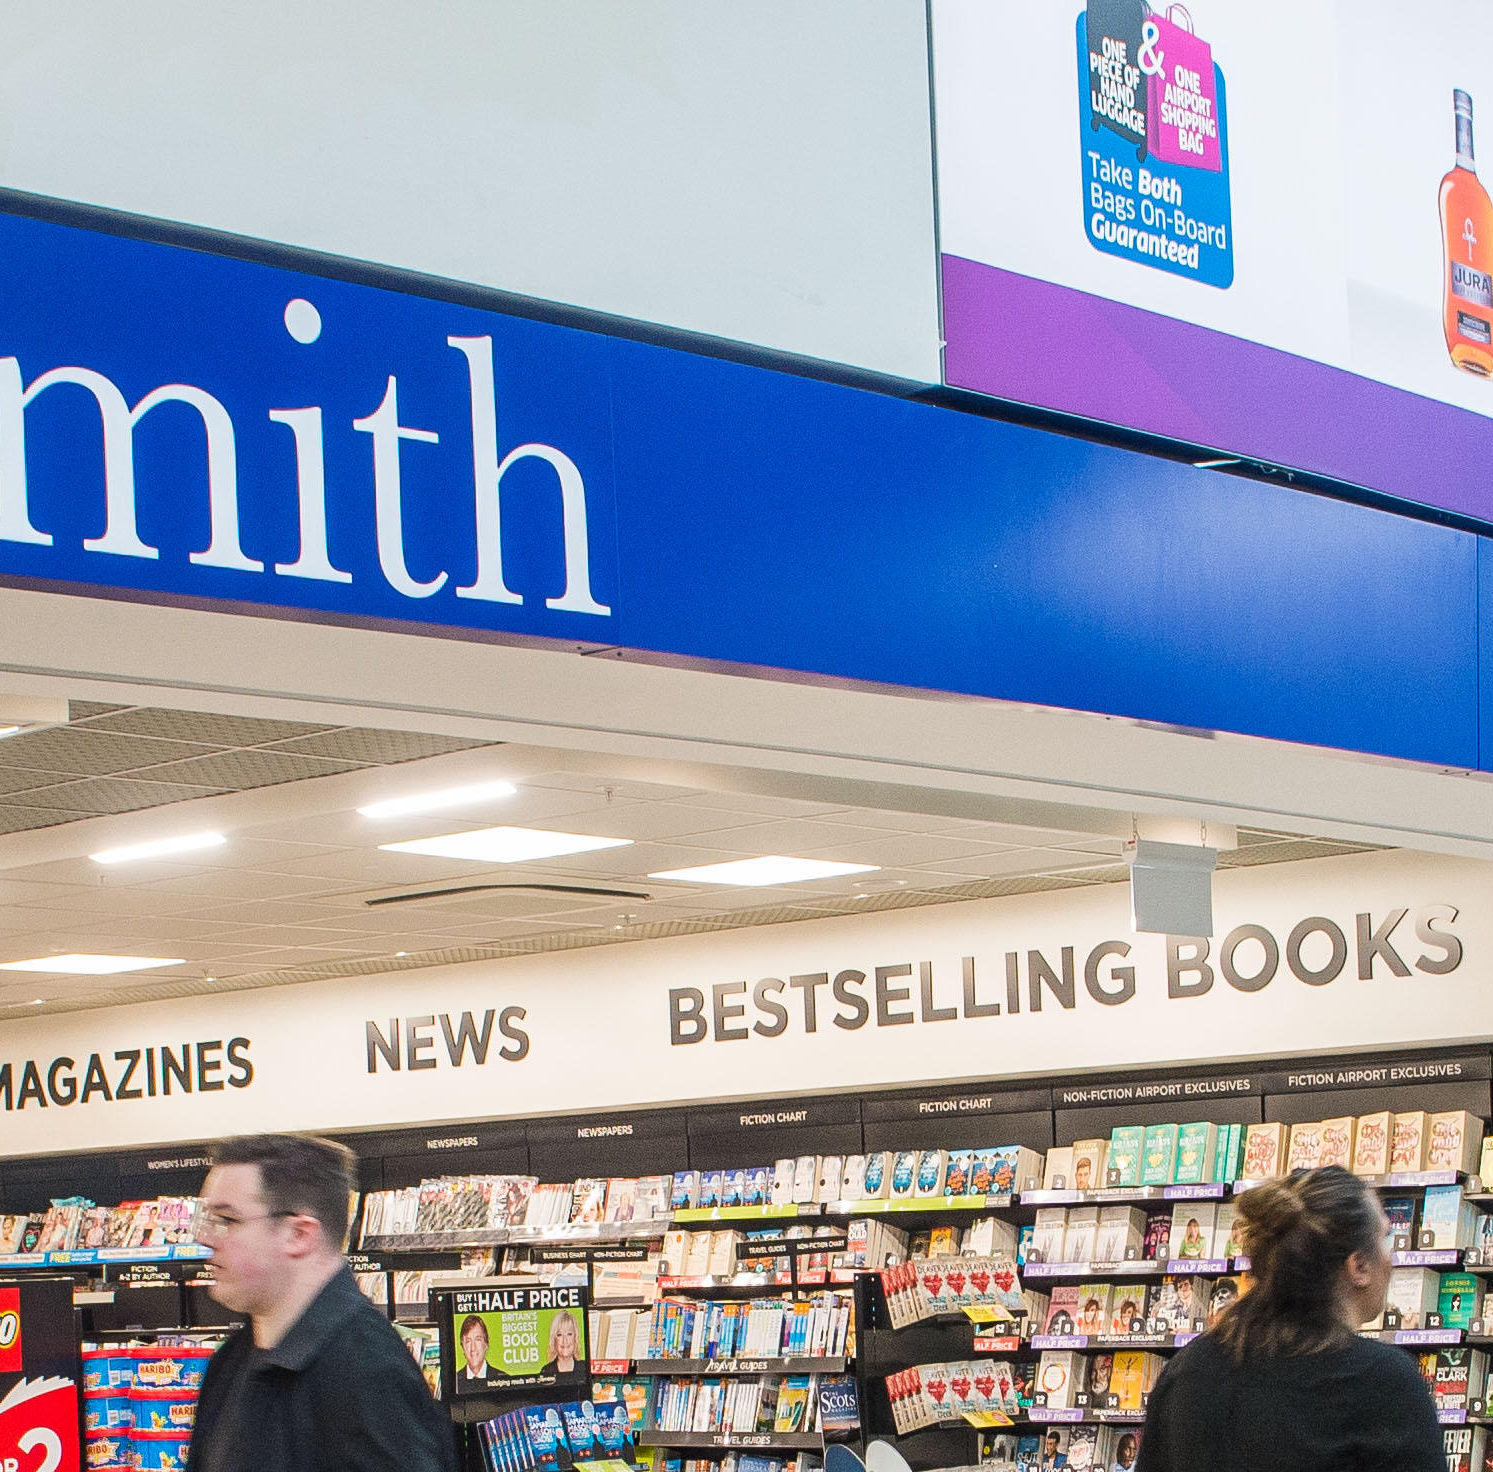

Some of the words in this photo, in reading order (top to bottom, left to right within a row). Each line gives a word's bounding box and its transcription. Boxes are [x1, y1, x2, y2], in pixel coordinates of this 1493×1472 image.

[1102, 36, 1127, 66] ONE
[1138, 20, 1165, 81] &
[1090, 53, 1125, 84] PIECE
[1124, 65, 1140, 87] OF
[1175, 65, 1200, 95] ONE
[1100, 76, 1134, 108] HAND
[1164, 83, 1212, 118] AIRPORT
[1092, 91, 1146, 136] LUGGAGE
[1161, 103, 1216, 139] SHOPPING
[1179, 129, 1203, 155] BAG
[1088, 151, 1133, 190] Take
[1138, 168, 1182, 207] Both
[1090, 182, 1135, 222] Bags
[1141, 199, 1226, 250] On-Board
[1091, 213, 1199, 269] Guaranteed
[1454, 268, 1490, 293] JURA
[669, 939, 1137, 1046] BESTSELLING
[1167, 904, 1463, 999] BOOKS
[365, 1006, 531, 1074] NEWS
[1288, 1072, 1330, 1088] FICTION
[1335, 1067, 1387, 1084] AIRPORT
[1390, 1063, 1462, 1079] EXCLUSIVES
[1063, 1086, 1133, 1104] NON-FICTION
[1136, 1083, 1182, 1099] AIRPORT
[1184, 1079, 1250, 1095] EXCLUSIVES
[919, 1100, 957, 1113] FICTION
[959, 1098, 992, 1111] CHART
[740, 1113, 775, 1126] FICTION
[777, 1111, 807, 1123] CHART
[427, 1137, 478, 1149] NEWSPAPERS
[577, 1125, 633, 1138] NEWSPAPERS
[1194, 1188, 1218, 1197] PRICE
[918, 1265, 941, 1274] DEAVER
[1174, 1265, 1195, 1273] HALF
[1197, 1264, 1222, 1272] PRICE
[1425, 1254, 1452, 1263] PRICE
[478, 1292, 524, 1311] HALF
[530, 1289, 579, 1308] PRICE
[502, 1312, 538, 1322] BRITAIN'S
[502, 1322, 538, 1332] BIGGEST
[503, 1333, 538, 1347] BOOK
[1036, 1340, 1055, 1348] HALF
[1057, 1339, 1081, 1347] PRICE
[1429, 1334, 1454, 1343] PRICE
[503, 1349, 539, 1364] CLUB
[139, 1364, 171, 1375] HARIBO
[821, 1391, 856, 1414] Scots
